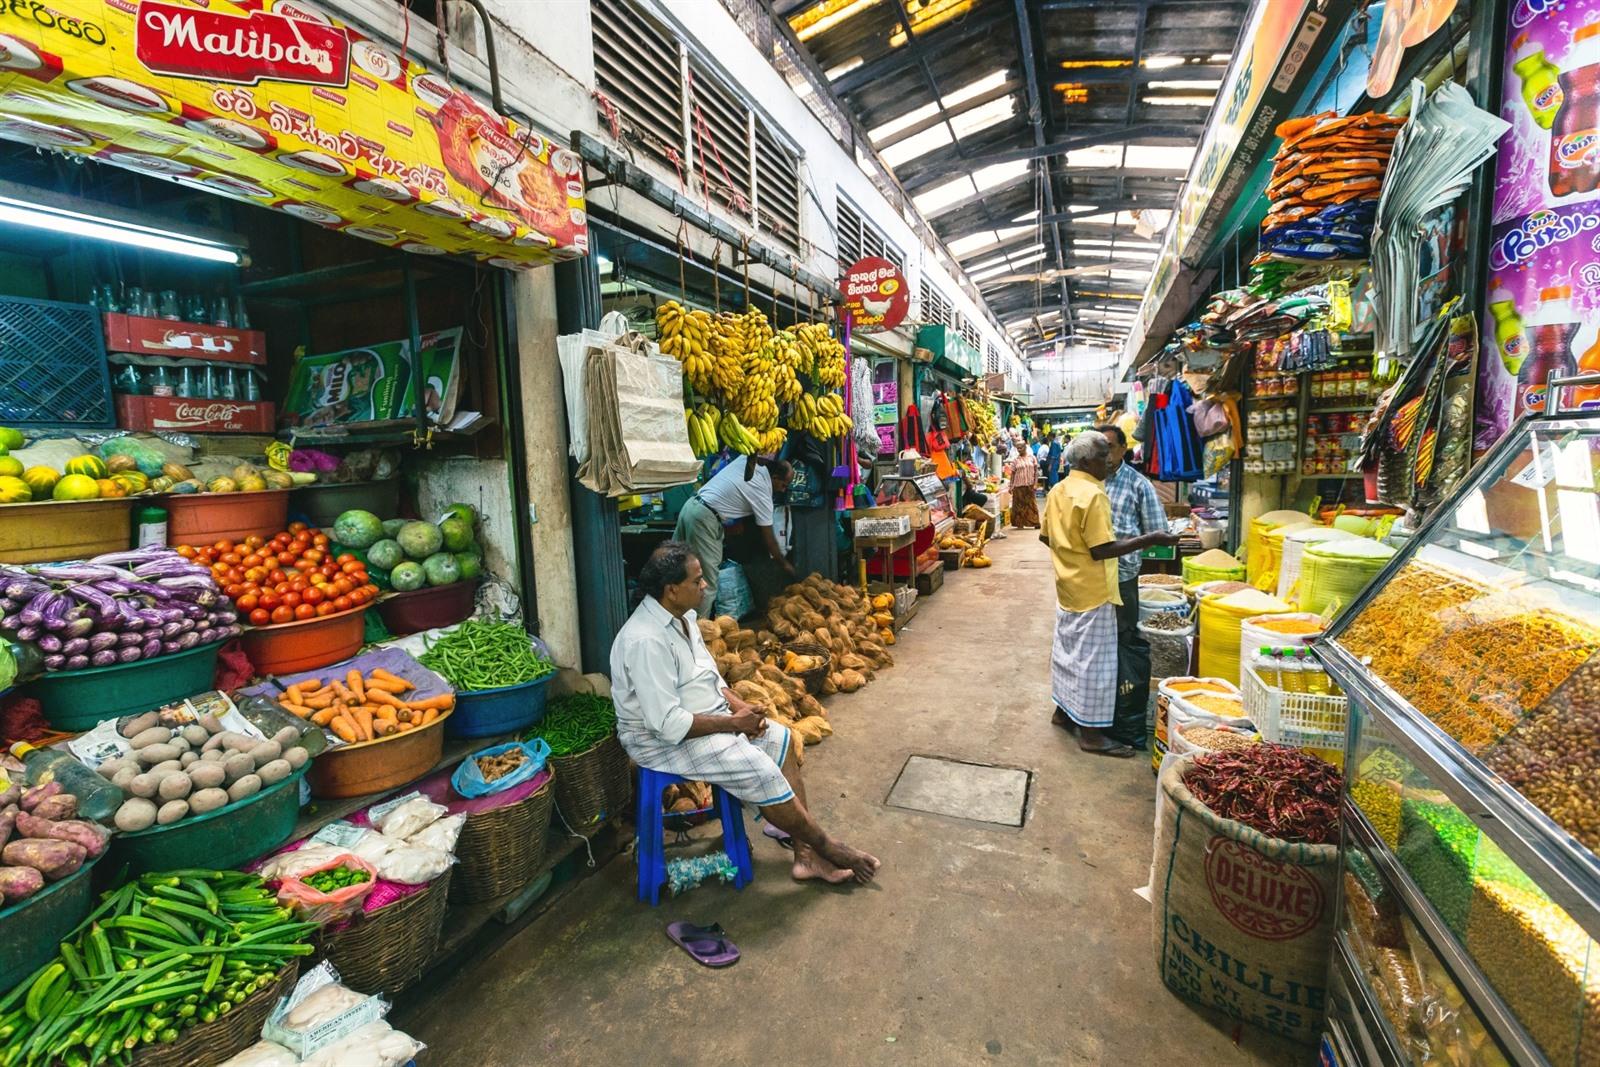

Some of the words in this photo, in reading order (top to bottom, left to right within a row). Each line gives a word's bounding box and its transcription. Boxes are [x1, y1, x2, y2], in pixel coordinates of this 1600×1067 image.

[1502, 213, 1599, 263] Portello
[1522, 212, 1559, 233] Fanta
[328, 363, 347, 402] MILO
[1525, 391, 1546, 406] Fan
[176, 402, 233, 421] Coca-Cola
[1216, 853, 1312, 918] DELUXE
[1170, 942, 1204, 979] NET
[1263, 1004, 1302, 1027] 25
